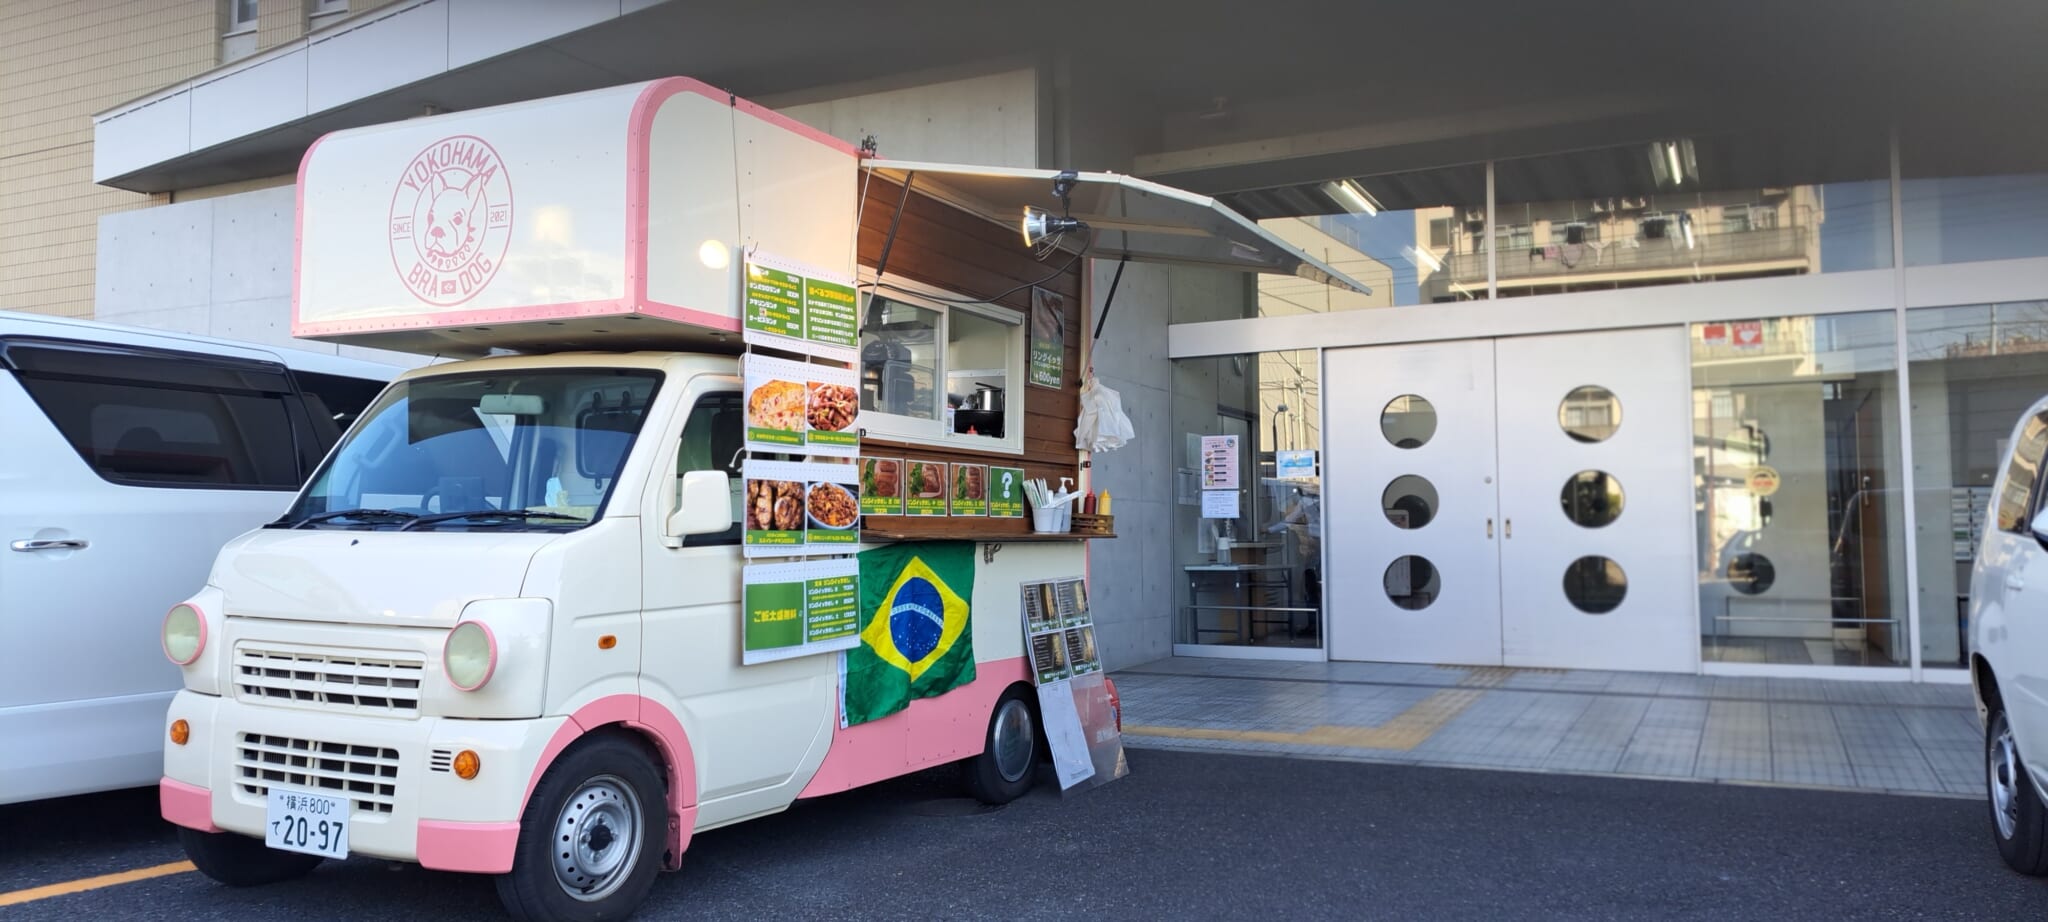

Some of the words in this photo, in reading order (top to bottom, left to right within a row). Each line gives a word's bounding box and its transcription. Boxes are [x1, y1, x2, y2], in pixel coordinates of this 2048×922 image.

[404, 141, 498, 192] YOKOHAMA
[392, 221, 412, 234] SINCE
[489, 210, 508, 223] 2021
[408, 261, 438, 298] BRA
[458, 252, 492, 295] DOG
[271, 820, 281, 836] て
[283, 815, 344, 853] 20-97
